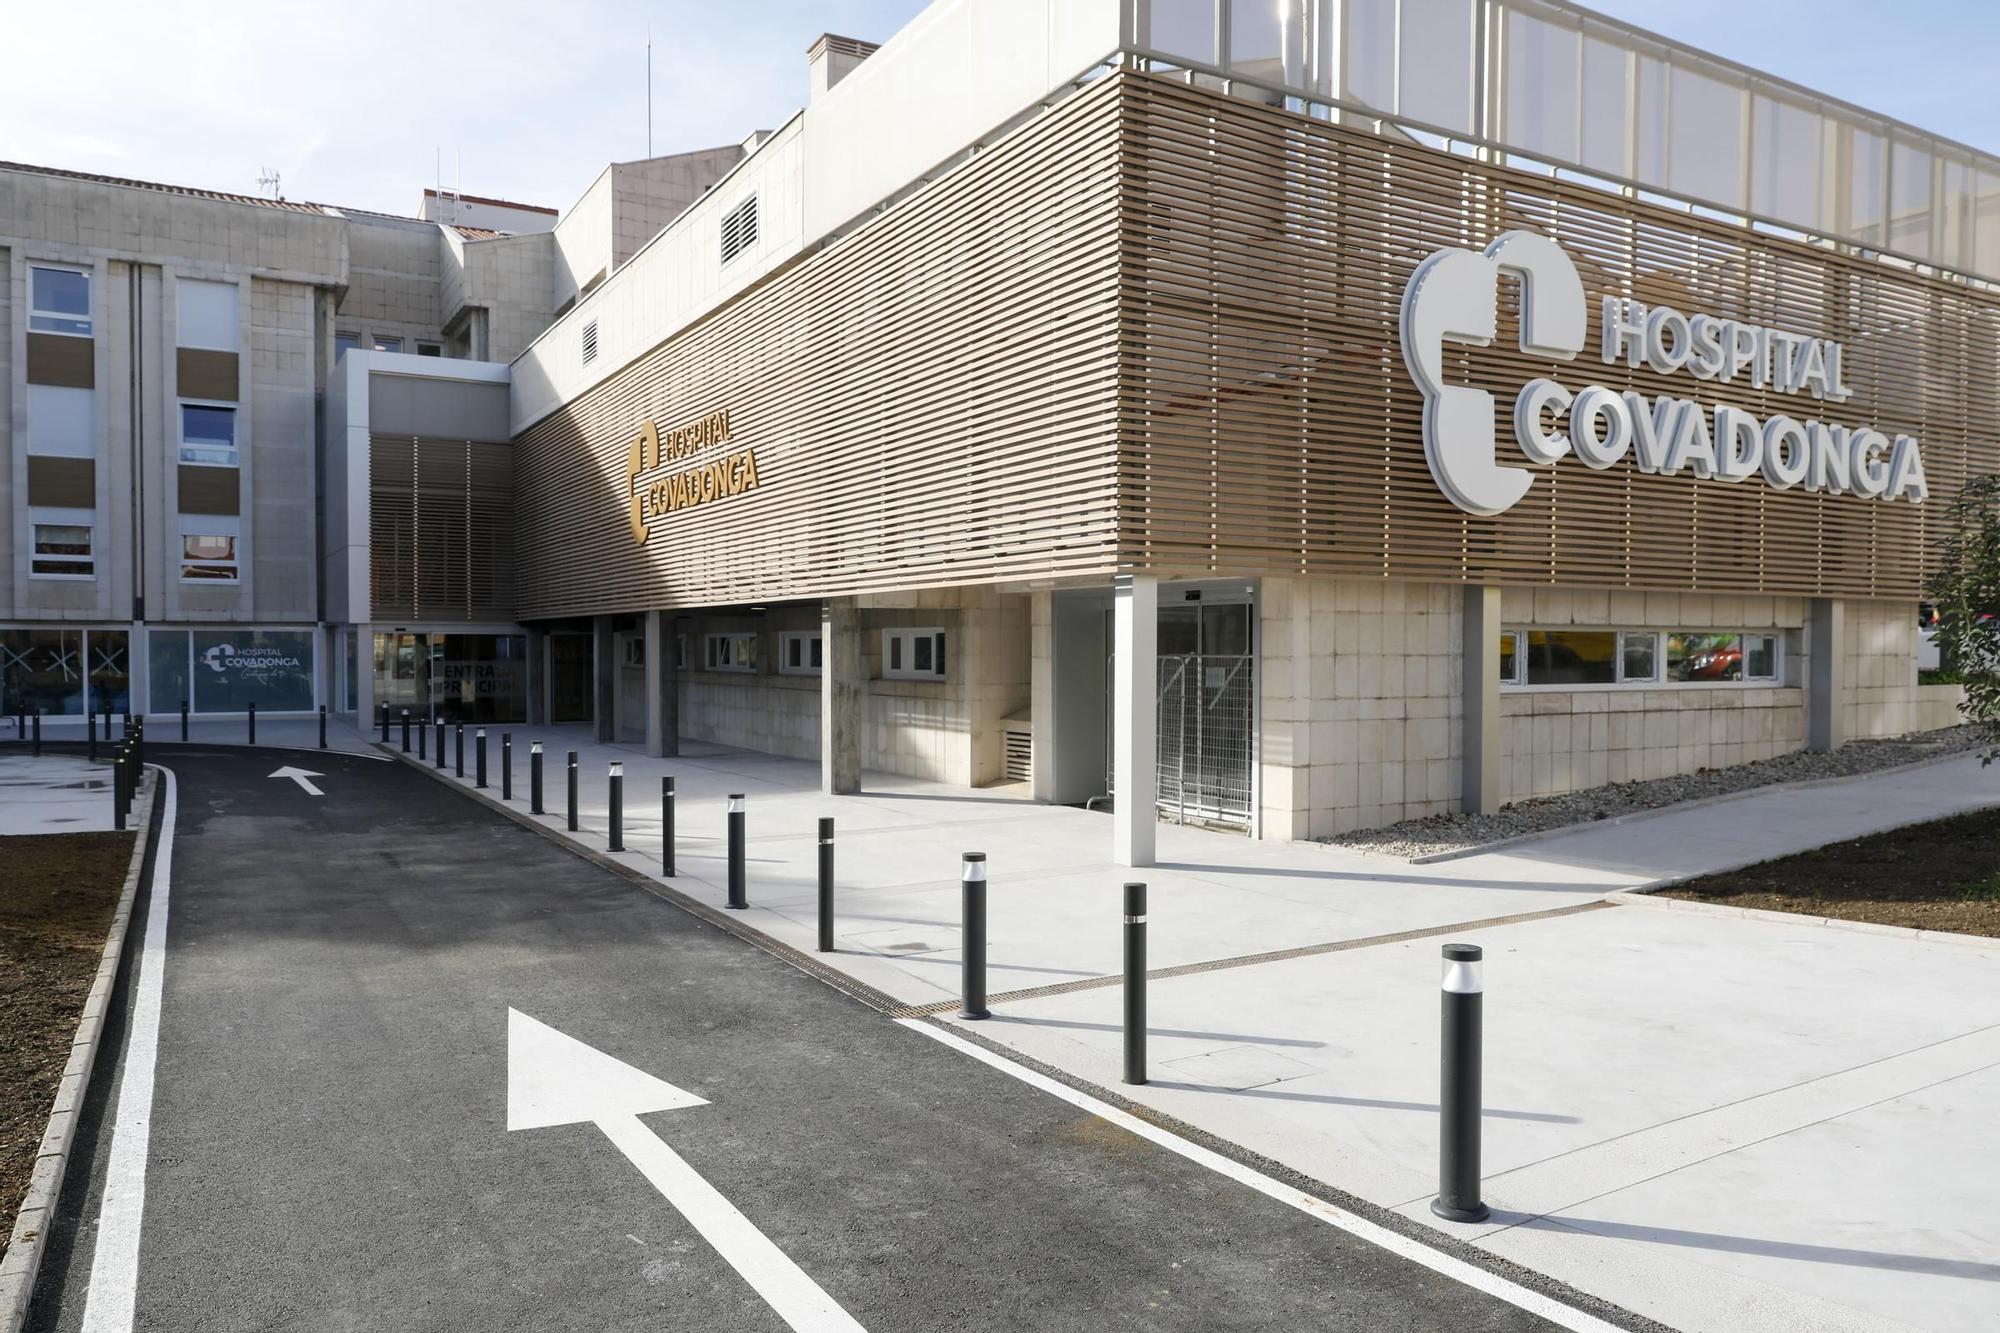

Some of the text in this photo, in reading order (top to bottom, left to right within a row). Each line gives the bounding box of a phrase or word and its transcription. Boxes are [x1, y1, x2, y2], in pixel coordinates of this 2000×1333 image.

[1602, 295, 1853, 401] HOSPITAL
[665, 408, 734, 461] HOSPITAL
[1513, 377, 1928, 503] COVADONGA
[648, 448, 760, 517] COVADONGA
[225, 657, 300, 666] COVADONGA
[238, 648, 282, 656] HOSPITAL
[445, 665, 513, 678] ENTRA
